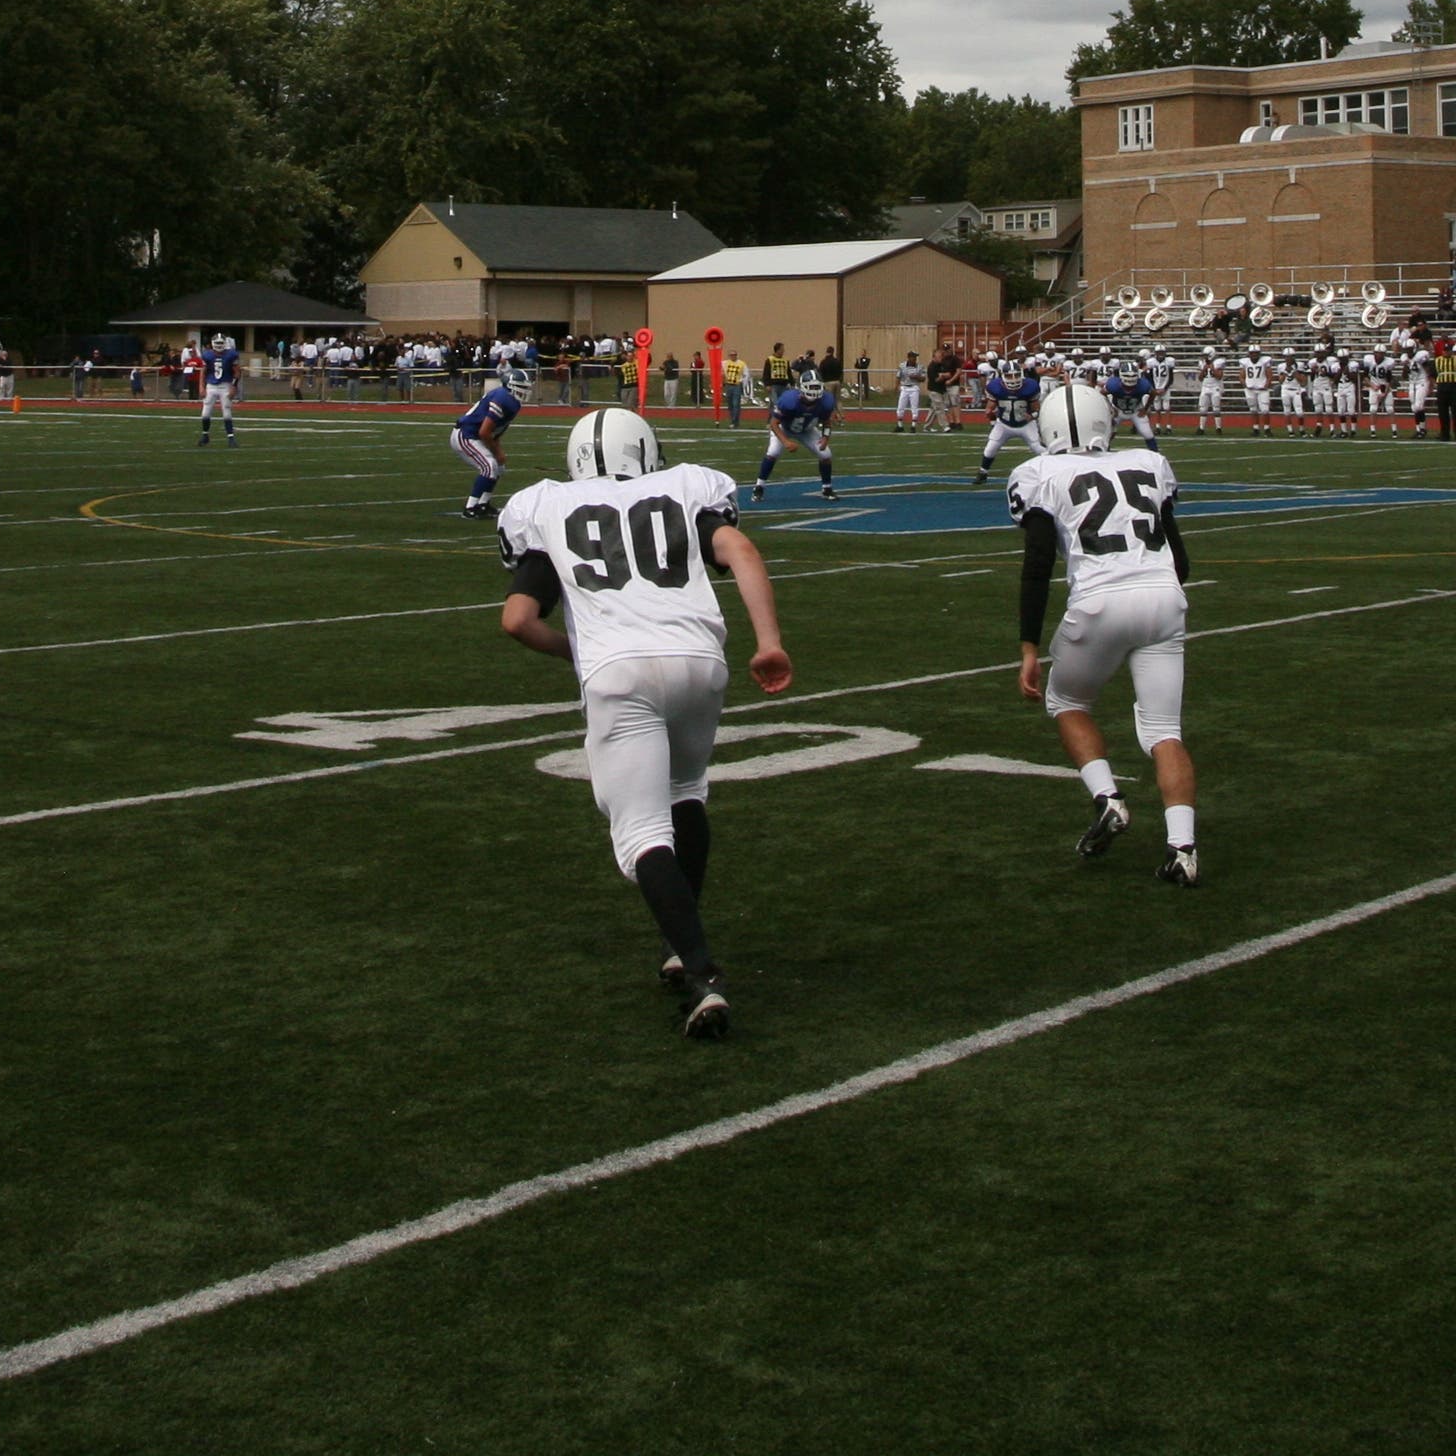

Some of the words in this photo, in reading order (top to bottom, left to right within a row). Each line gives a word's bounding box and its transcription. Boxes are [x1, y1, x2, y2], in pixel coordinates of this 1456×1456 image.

[213, 361, 224, 380] 5
[1069, 367, 1087, 379] 72
[1154, 365, 1168, 378] 12
[1247, 366, 1263, 379] 67
[998, 399, 1029, 422] 76
[1069, 469, 1166, 555] 25
[565, 494, 690, 593] 90
